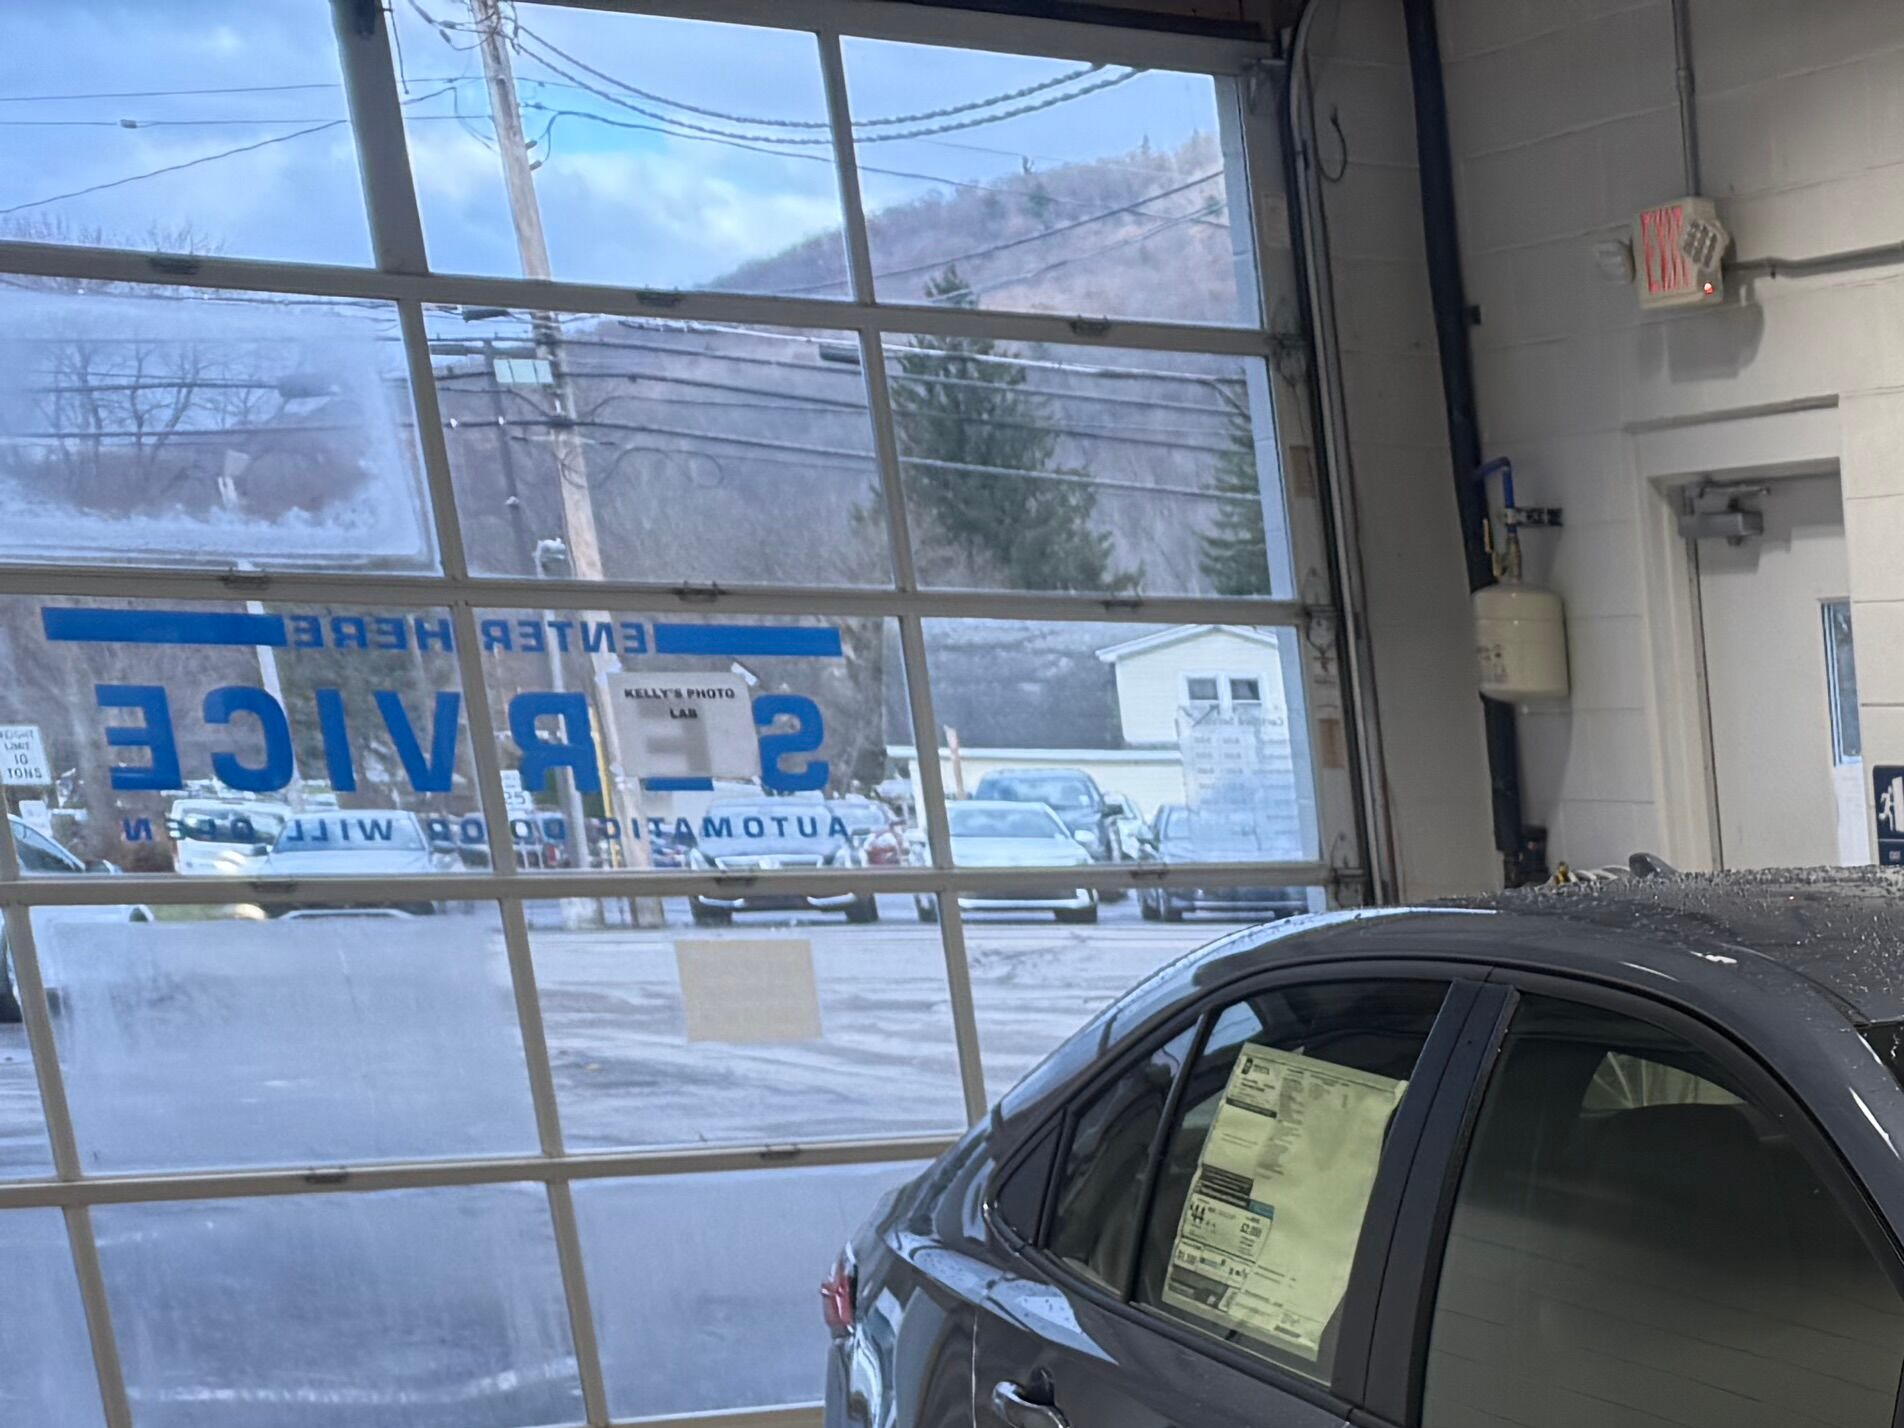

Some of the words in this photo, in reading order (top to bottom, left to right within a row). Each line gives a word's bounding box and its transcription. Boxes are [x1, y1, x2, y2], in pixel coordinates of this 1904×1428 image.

[624, 687, 683, 699] KELLY'S
[686, 687, 735, 699] PHOTO
[669, 707, 698, 719] LAB
[14, 753, 29, 766] 10
[7, 767, 43, 779] TONS
